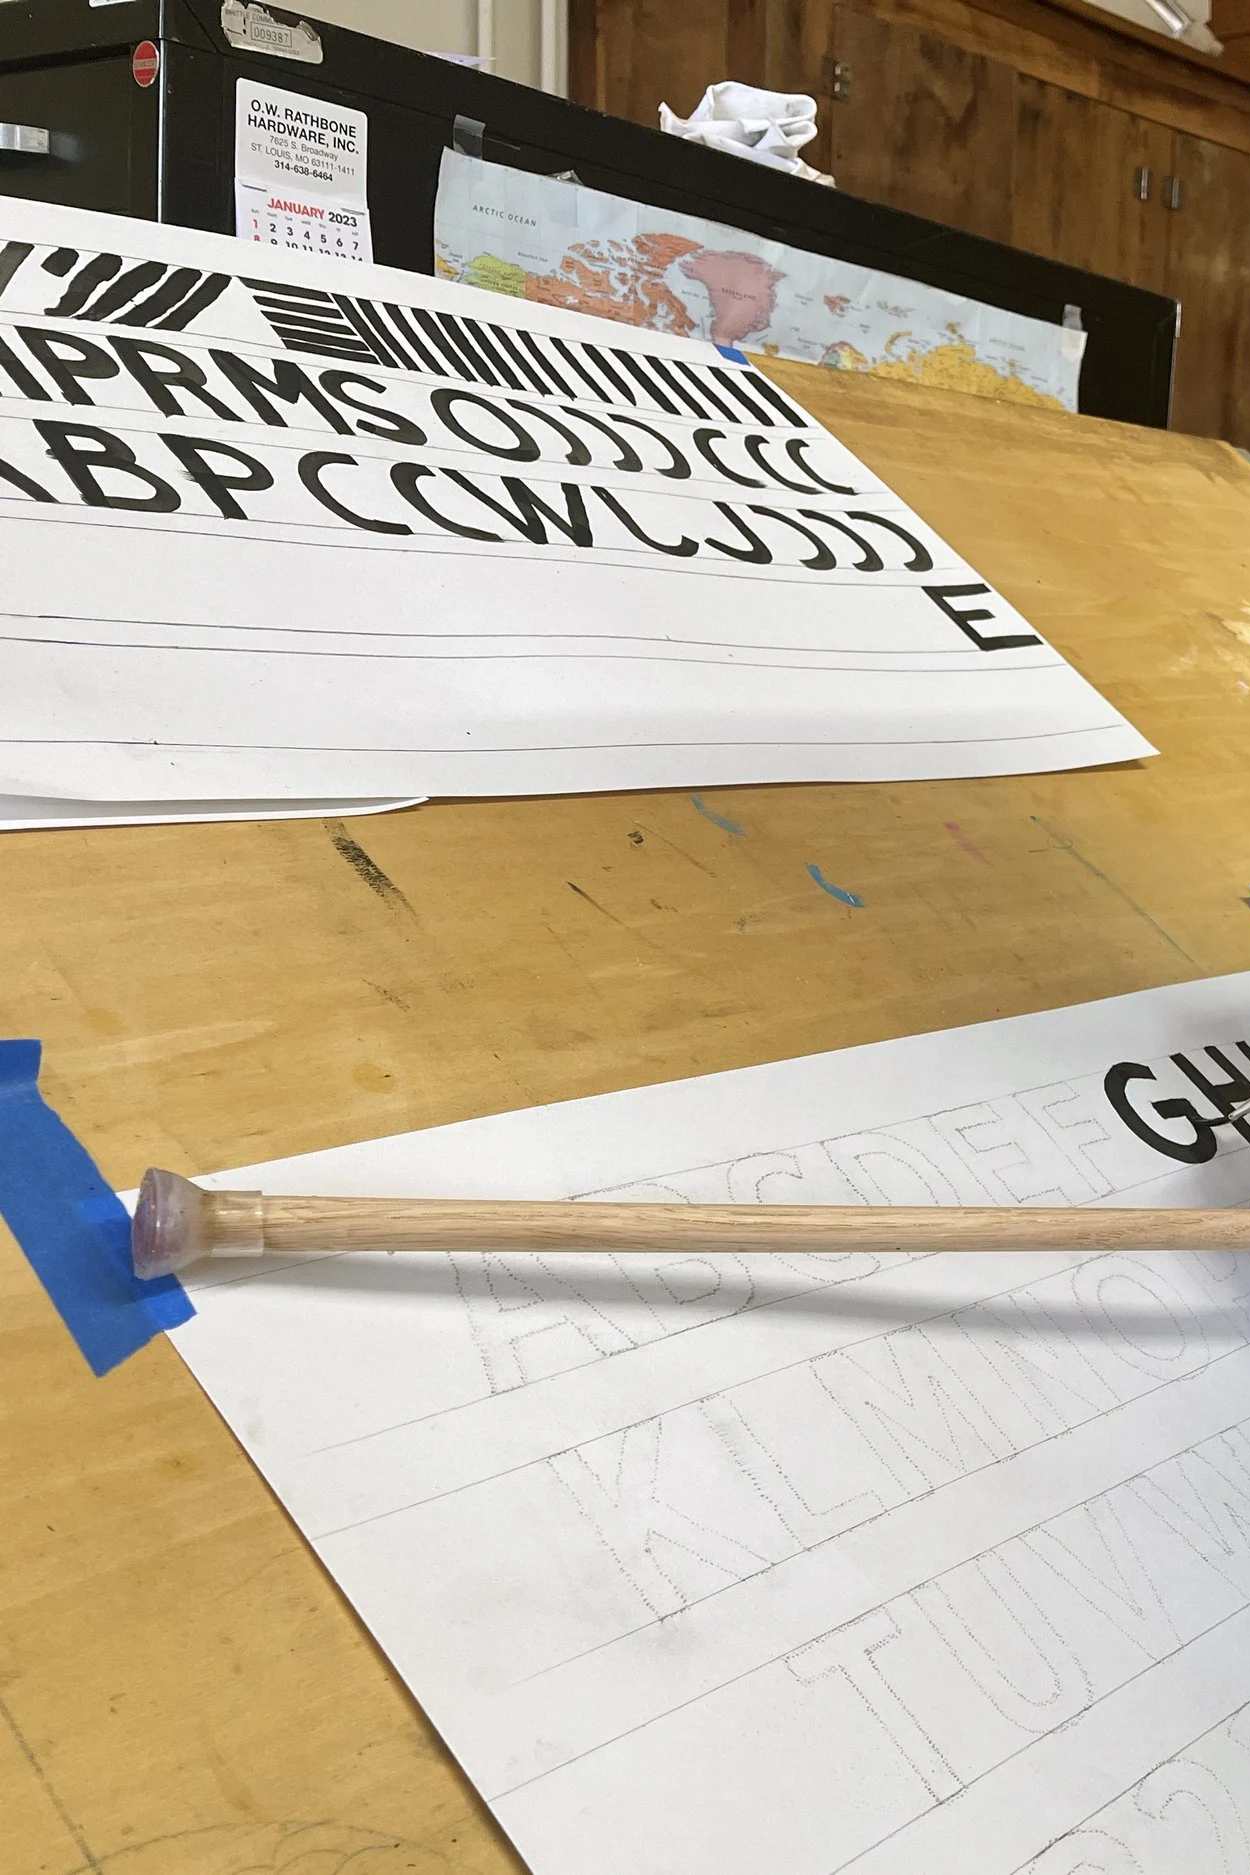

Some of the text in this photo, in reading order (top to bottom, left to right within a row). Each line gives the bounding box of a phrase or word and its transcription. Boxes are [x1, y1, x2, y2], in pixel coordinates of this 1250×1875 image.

[253, 26, 289, 44] 009387
[251, 99, 357, 139] O.W. RATHBONE
[247, 114, 359, 155] HARDWARE, INC.
[270, 135, 289, 148] 7625
[301, 144, 339, 162] Broadway
[265, 146, 293, 162] LOUIS,
[295, 154, 309, 165] MO
[311, 158, 355, 176] 63111-1411
[274, 159, 333, 182] 314-638-6464
[267, 197, 358, 228] JANUARY 2023
[472, 204, 537, 228] ARCTIC OCEAN
[253, 218, 359, 251] 1 2 3 4 5 6 7
[921, 583, 1044, 652] E
